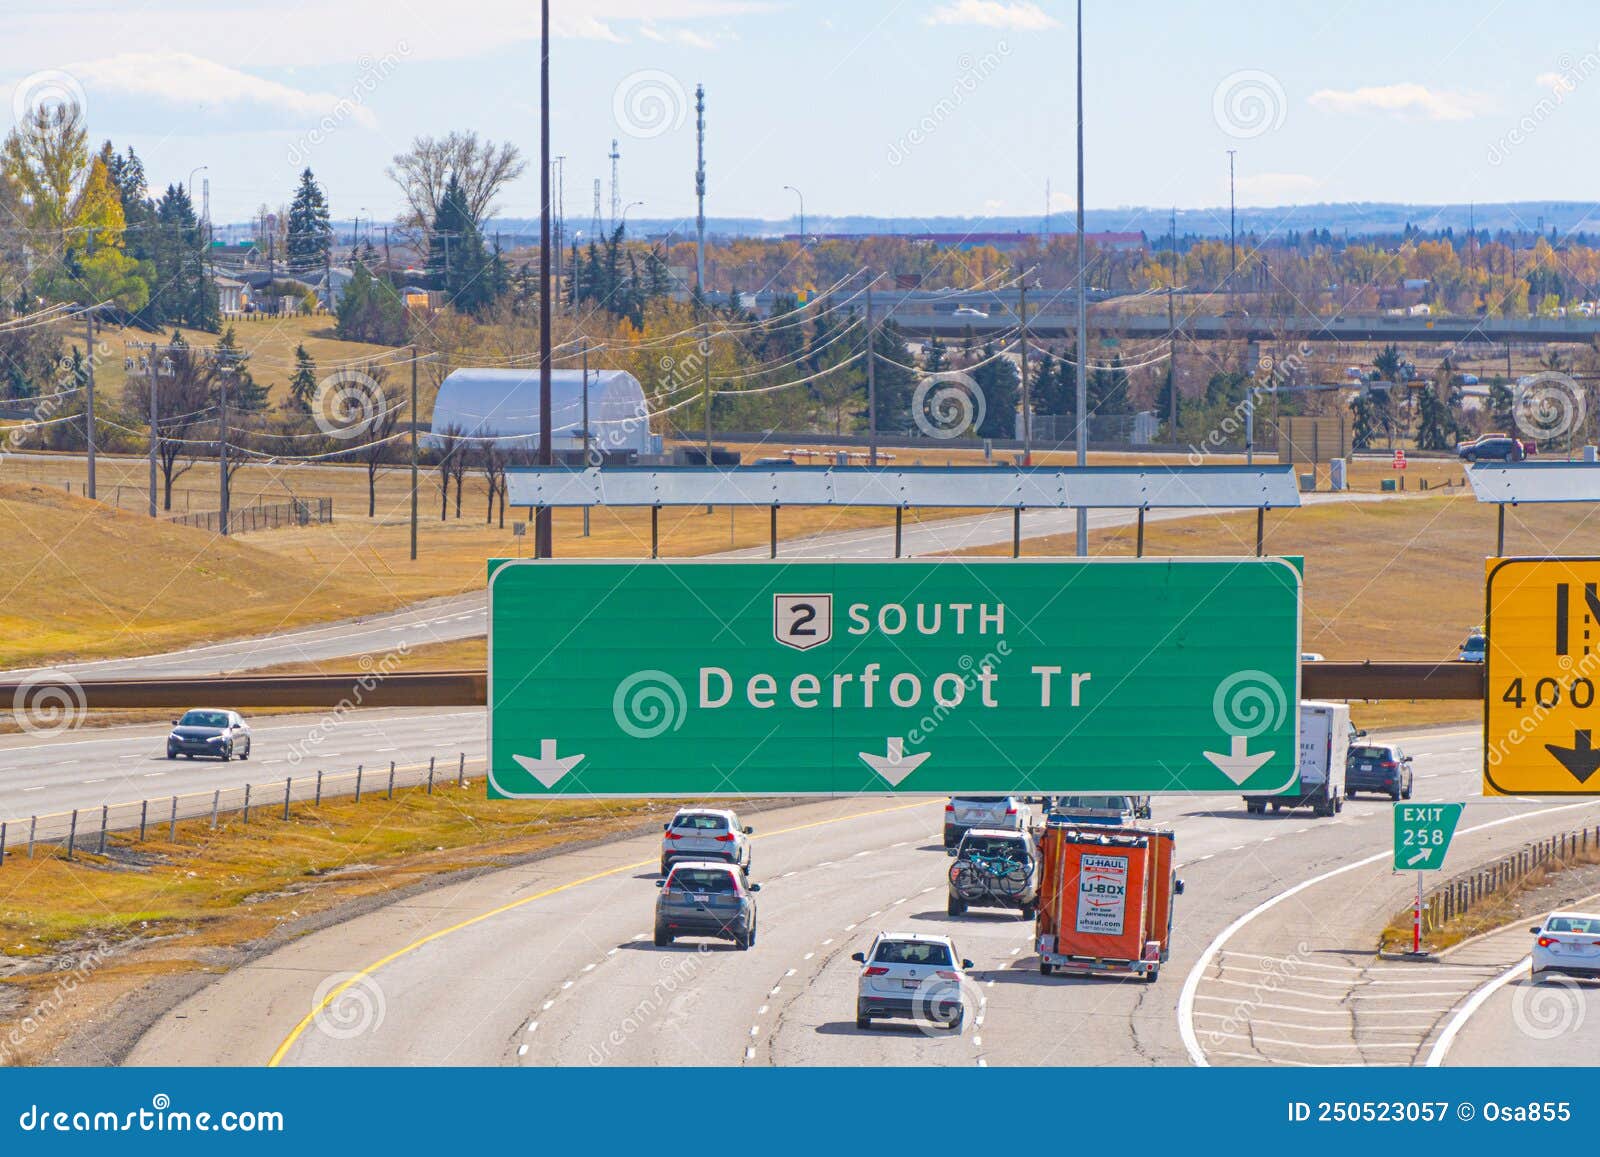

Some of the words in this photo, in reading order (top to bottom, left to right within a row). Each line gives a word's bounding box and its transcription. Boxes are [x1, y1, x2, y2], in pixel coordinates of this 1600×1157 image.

[789, 604, 817, 636] 2
[847, 603, 1005, 635] SOUTH
[700, 663, 998, 708] Deerfoot
[1031, 666, 1092, 707] Tr
[1502, 677, 1595, 709] 400
[1403, 808, 1443, 821] EXIT
[1403, 829, 1444, 846] 258
[1085, 858, 1123, 868] U-HAUL
[1081, 882, 1124, 895] U-BOX
[1079, 918, 1121, 927] uhaul.com
